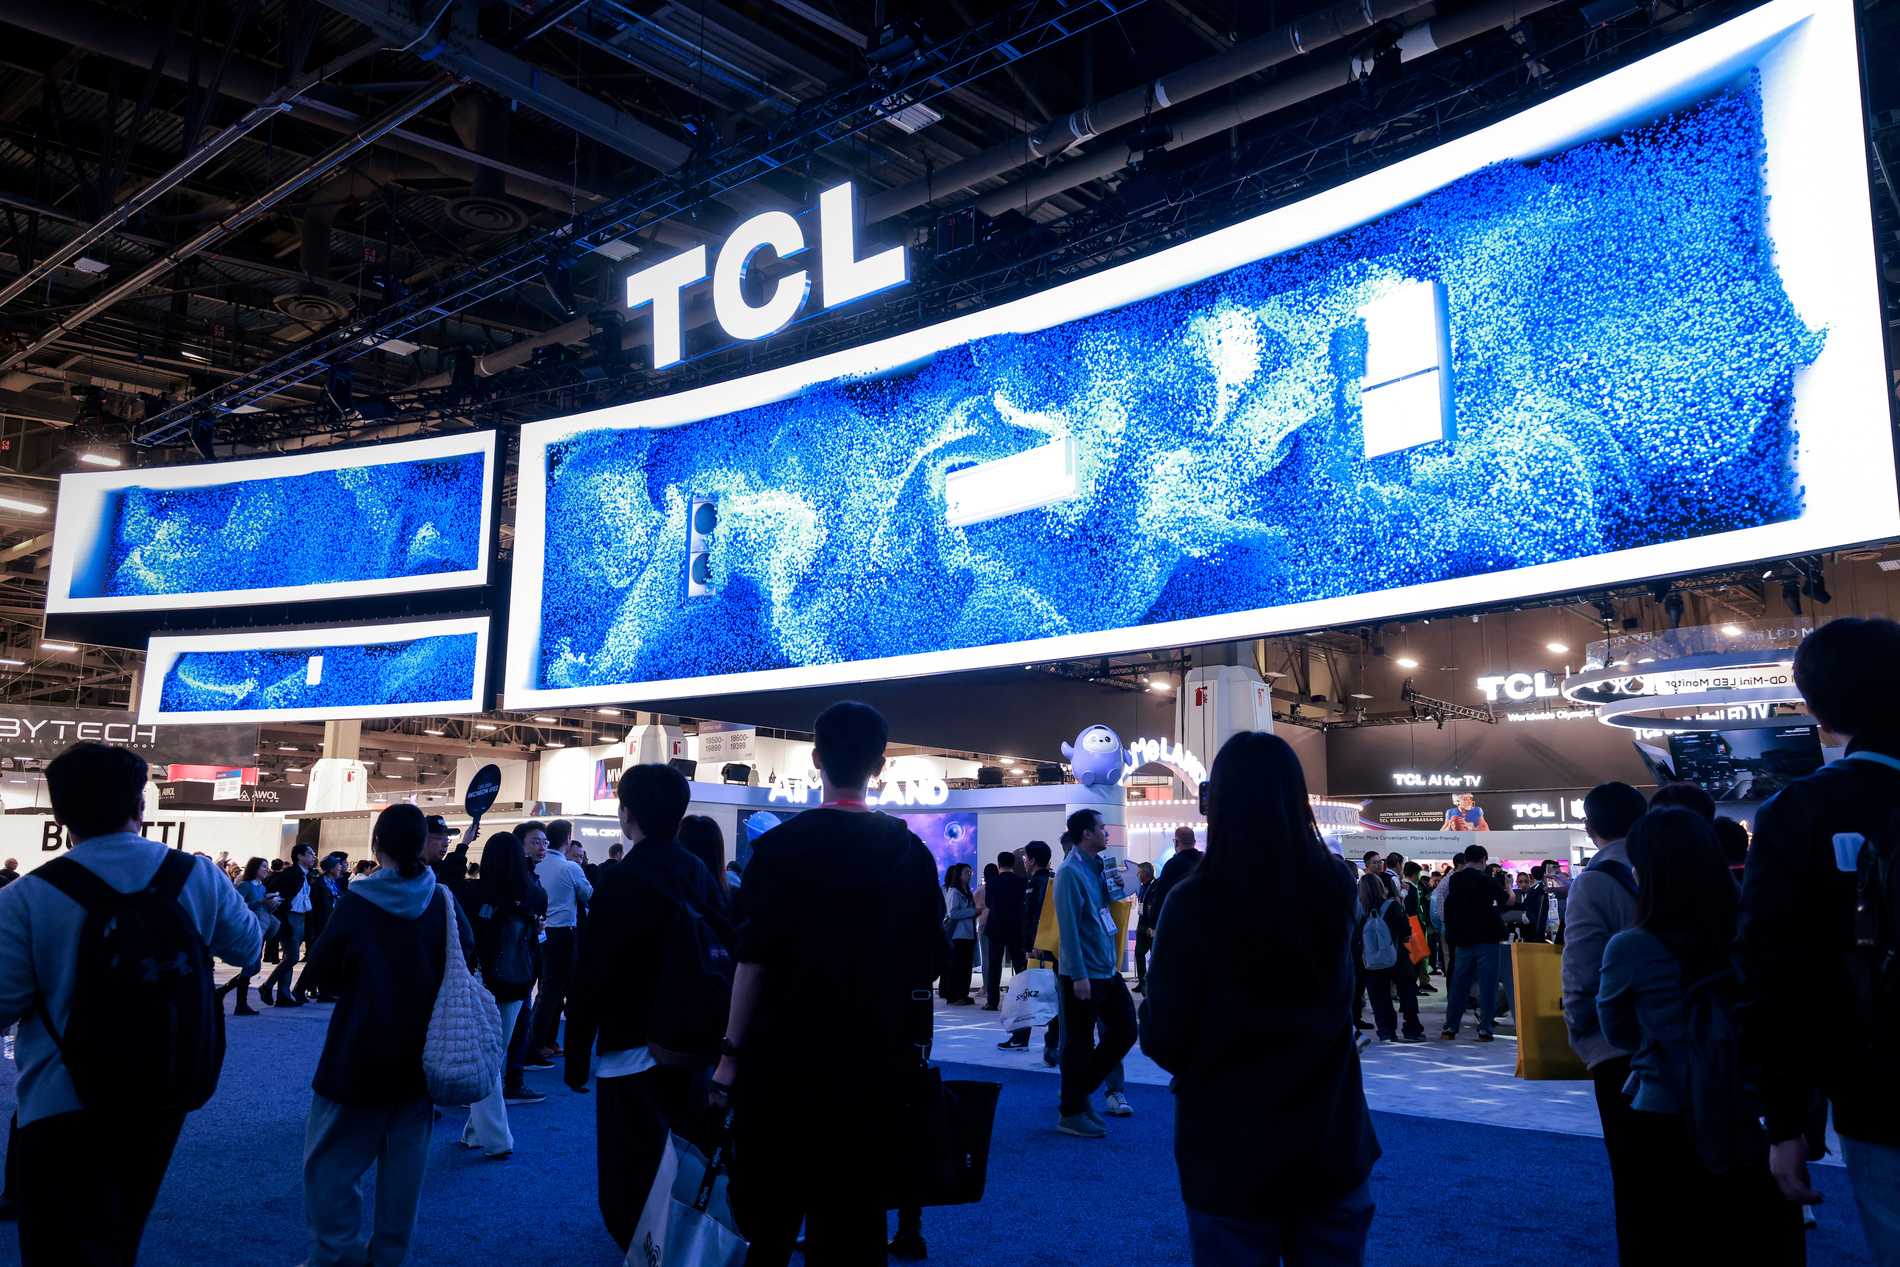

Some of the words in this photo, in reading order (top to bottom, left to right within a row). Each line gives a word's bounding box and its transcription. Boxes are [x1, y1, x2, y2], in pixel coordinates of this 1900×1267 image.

[627, 181, 911, 370] TCL
[1768, 628, 1798, 640] LED
[1477, 672, 1559, 701] TCL
[1507, 712, 1556, 721] Worldwide
[1556, 709, 1594, 720] Olympic
[1393, 773, 1426, 786] TCL
[1428, 774, 1443, 786] AI
[1444, 774, 1462, 786] for
[1463, 775, 1481, 787] TV
[252, 790, 279, 799] AWOL
[1512, 803, 1555, 818] TCL
[42, 821, 185, 851] BTTI
[581, 827, 598, 836] TCL
